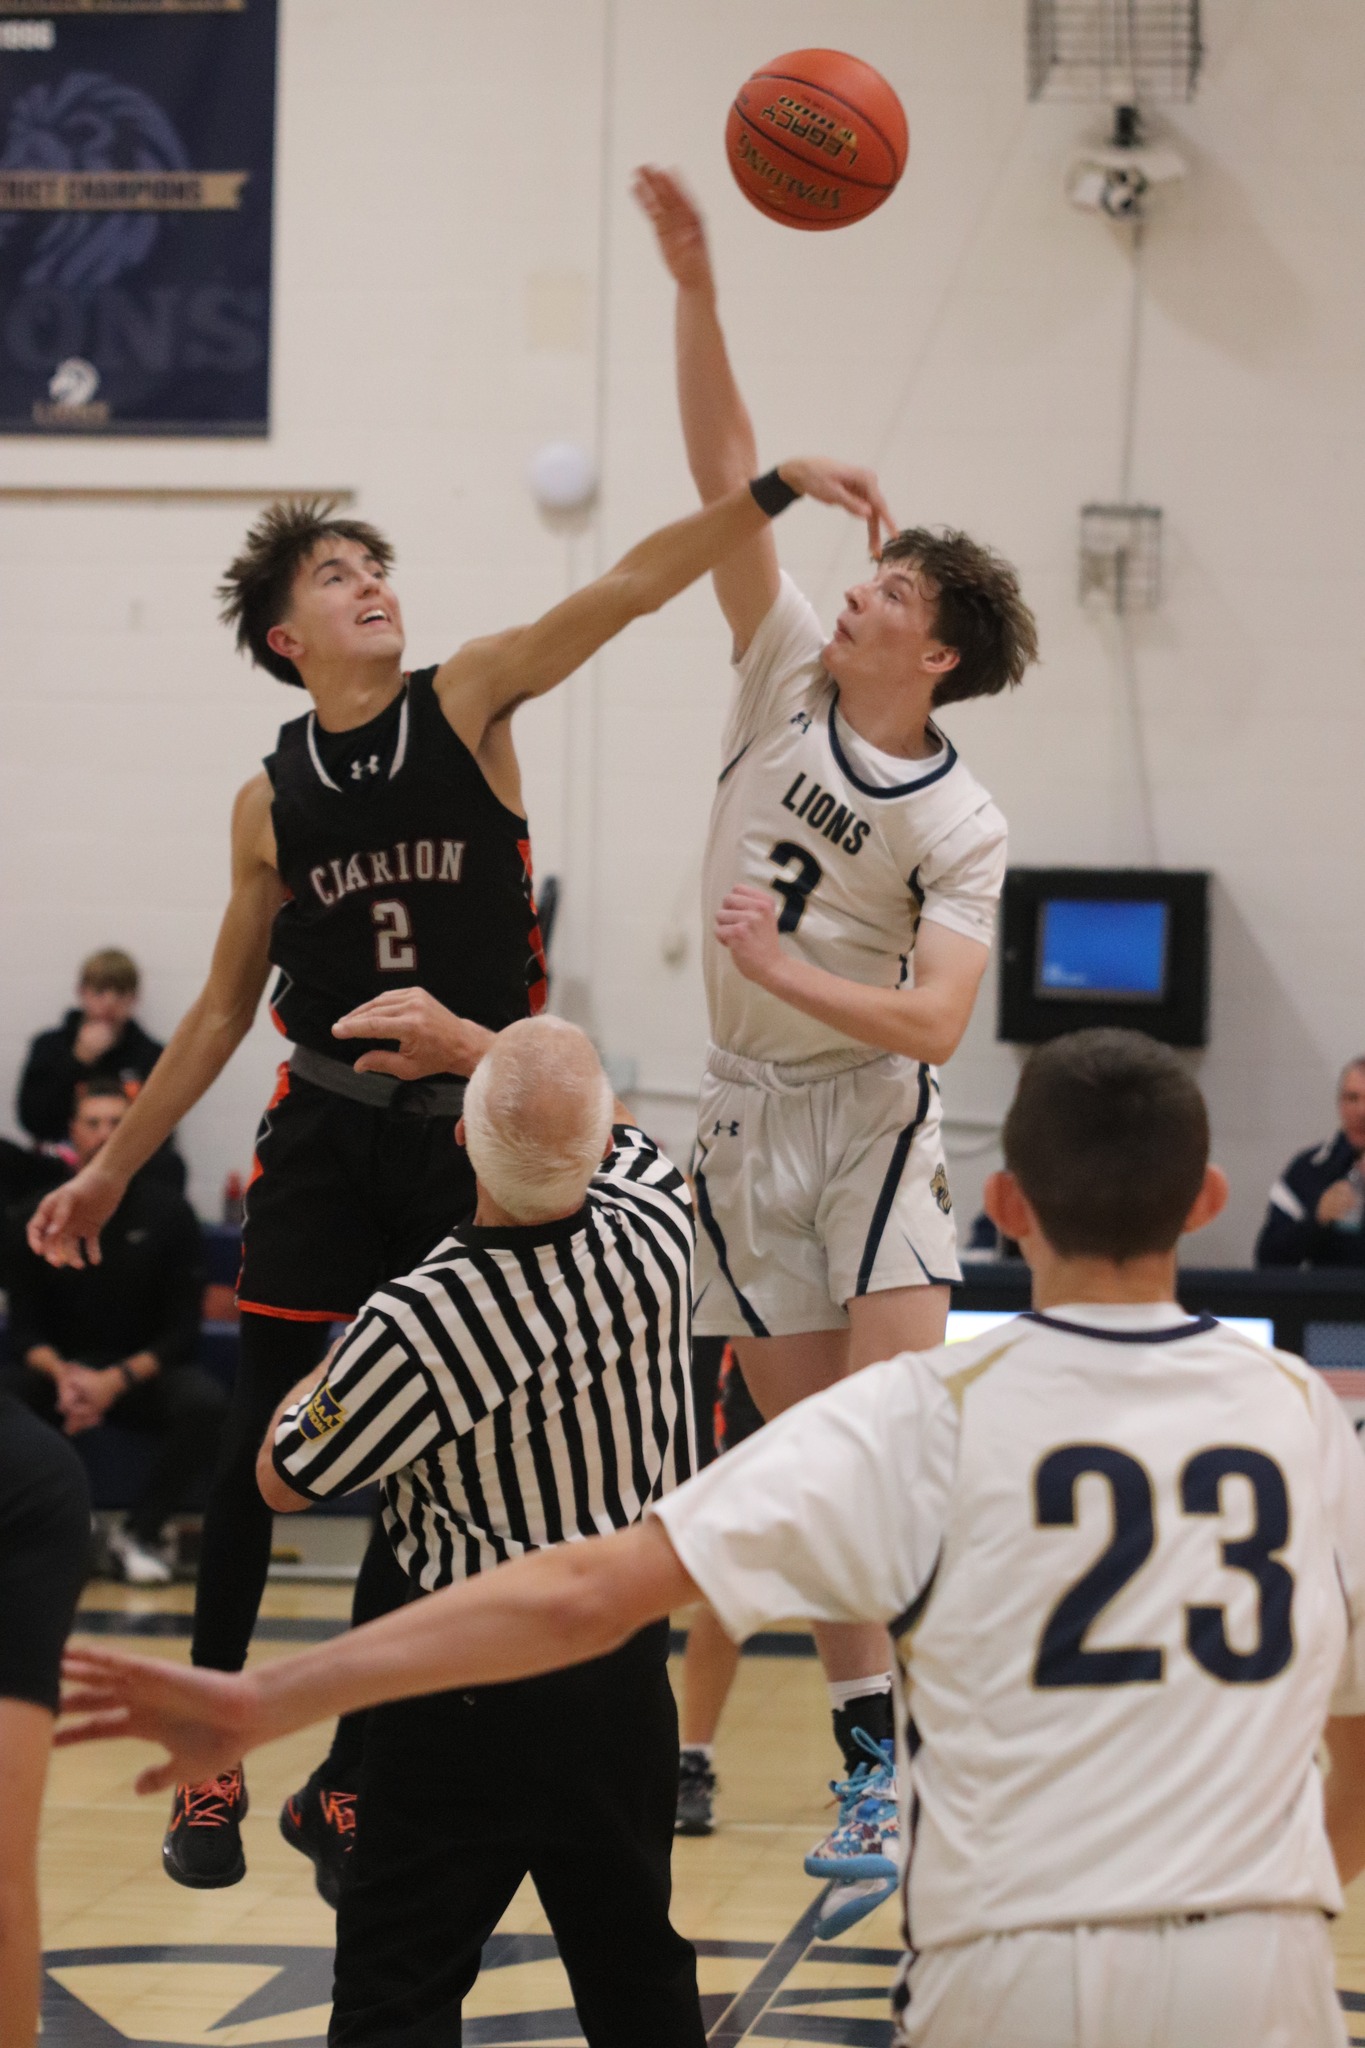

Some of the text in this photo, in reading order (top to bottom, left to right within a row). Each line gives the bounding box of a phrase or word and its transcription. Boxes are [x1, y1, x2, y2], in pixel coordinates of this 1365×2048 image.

[738, 130, 841, 209] SPALDING
[760, 104, 858, 167] LEGACY
[781, 772, 871, 855] LIONS
[310, 839, 467, 906] CLARION
[769, 839, 823, 934] 3
[371, 899, 417, 972] 2
[1032, 1442, 1296, 1690] 23
